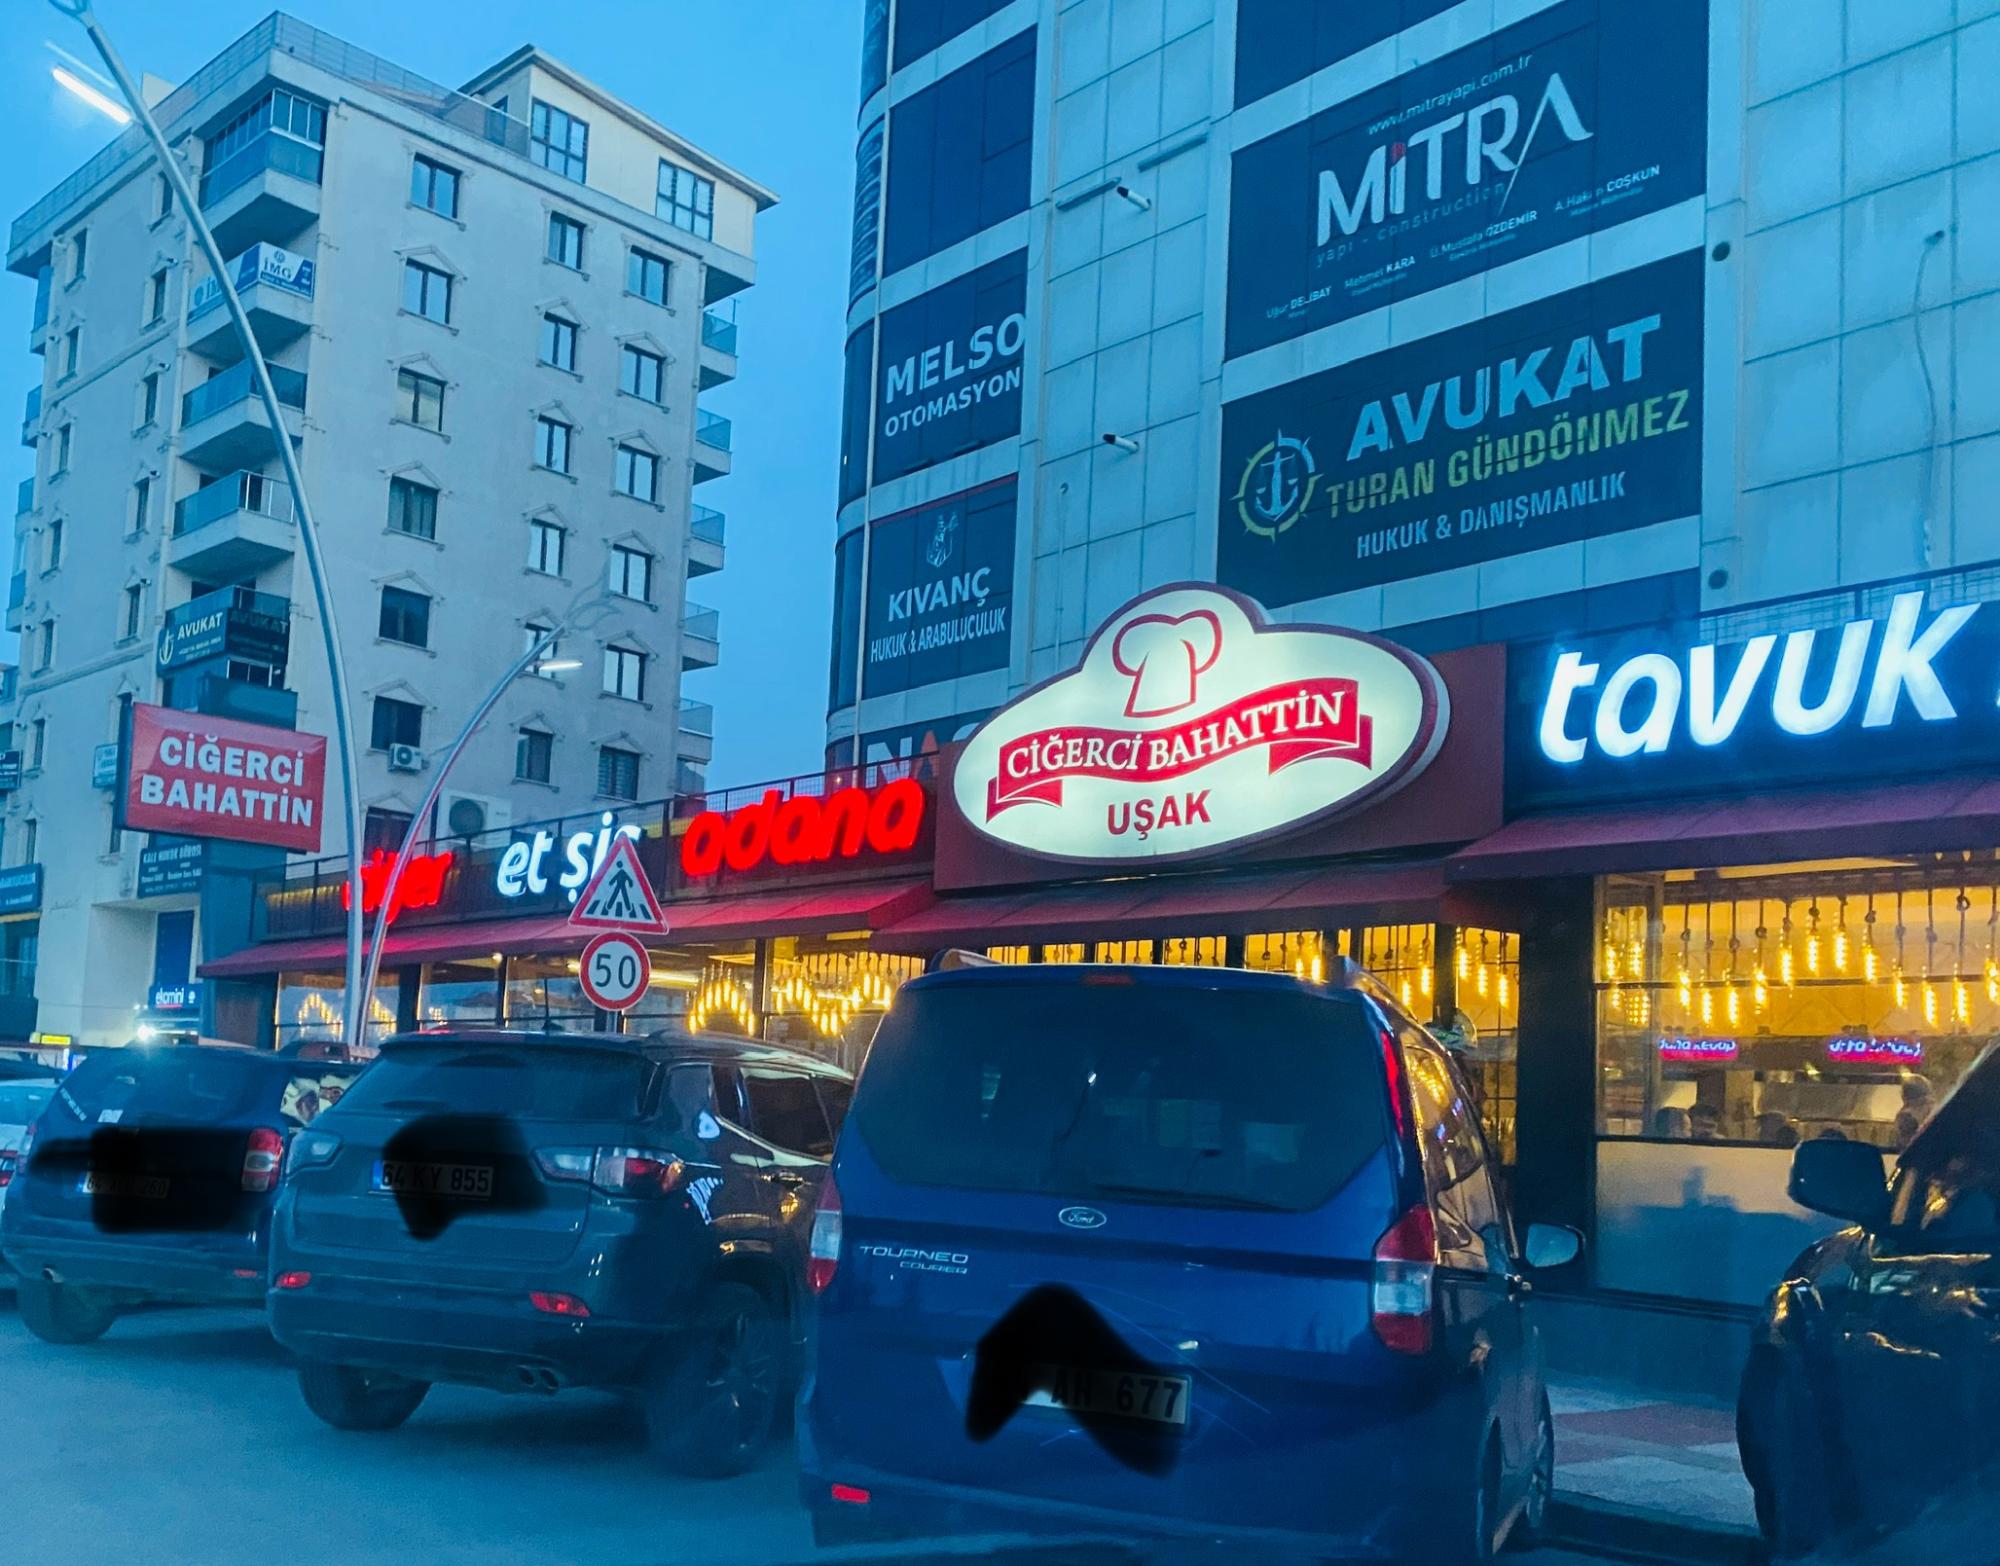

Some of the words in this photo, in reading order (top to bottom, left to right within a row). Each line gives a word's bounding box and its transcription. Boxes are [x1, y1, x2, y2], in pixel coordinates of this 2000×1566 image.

[1606, 164, 1661, 192] COŞKUN
[1386, 255, 1416, 274] KARA
[886, 312, 1026, 404] MELSO
[884, 366, 1021, 437] OTOMASYON
[1346, 313, 1662, 462] AVUKAT
[1326, 458, 1435, 518] TURAN
[1448, 388, 1690, 488] GÜNDÖNMEZ
[1356, 518, 1429, 559] HUKUK
[1436, 514, 1452, 539] &
[1460, 471, 1627, 534] DANIŞMANLIK
[888, 566, 991, 622] KIVANÇ
[177, 611, 224, 641] AVUKAT
[871, 631, 907, 664] HUKUK
[917, 606, 1007, 651] ARABULUCULUK
[1540, 590, 1982, 762] tavuk
[159, 732, 304, 787] CİĞERCİ
[1006, 731, 1143, 778] CİĞERCİ
[1146, 690, 1346, 771] BAHATTİN
[140, 774, 314, 828] BAHATTİN
[681, 776, 926, 877] adana
[1107, 789, 1212, 840] UŞAK
[497, 829, 555, 897] et
[595, 954, 637, 989] 50
[450, 1166, 490, 1194] 855
[860, 1246, 969, 1264] TOURNEO
[1118, 1375, 1184, 1419] 677
